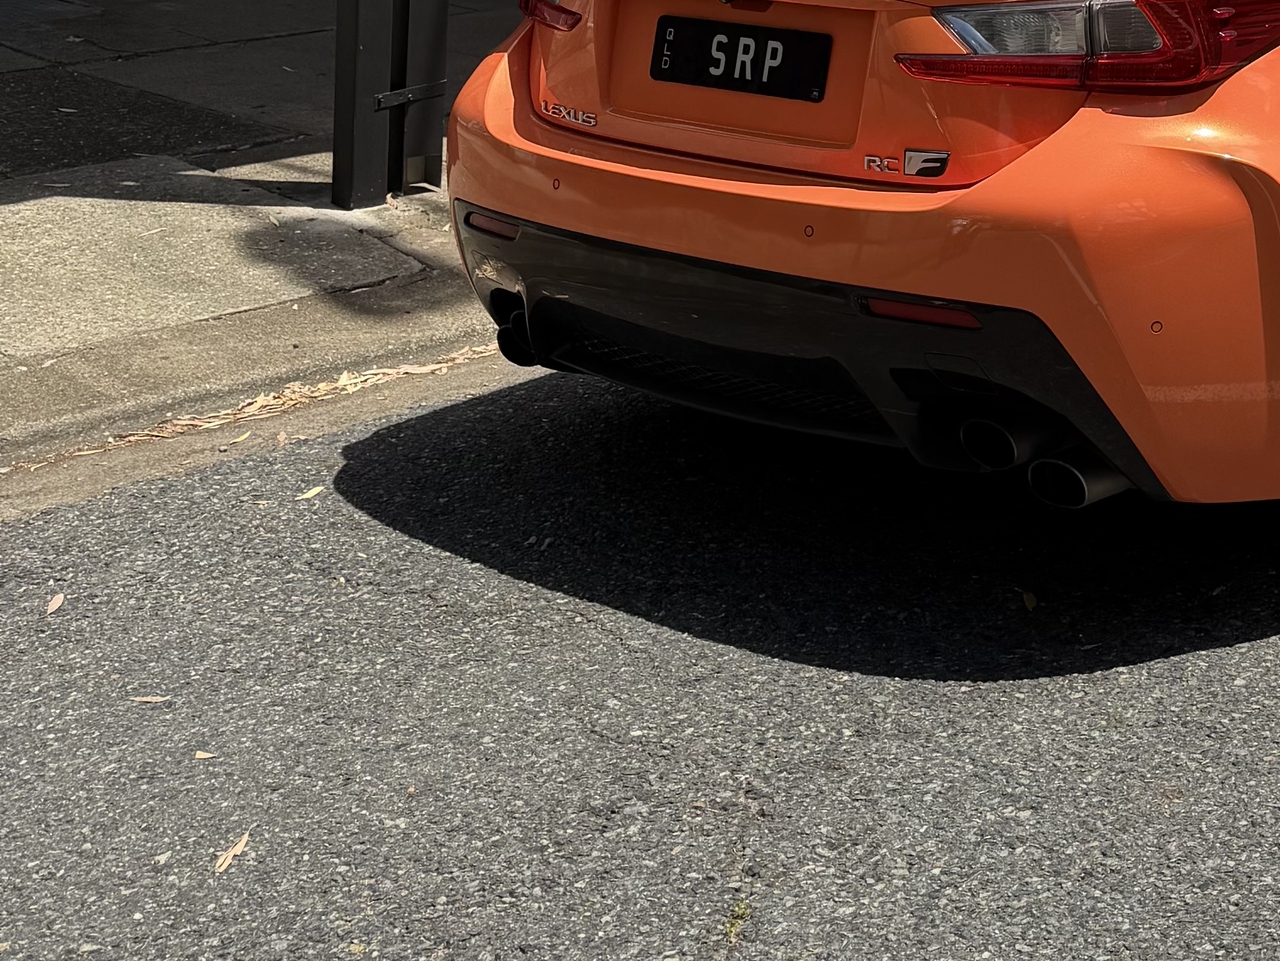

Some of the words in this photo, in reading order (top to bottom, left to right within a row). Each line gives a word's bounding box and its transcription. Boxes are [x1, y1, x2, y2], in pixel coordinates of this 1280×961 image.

[709, 34, 784, 82] SRP
[541, 100, 597, 127] LEXUS
[864, 155, 899, 174] RC
